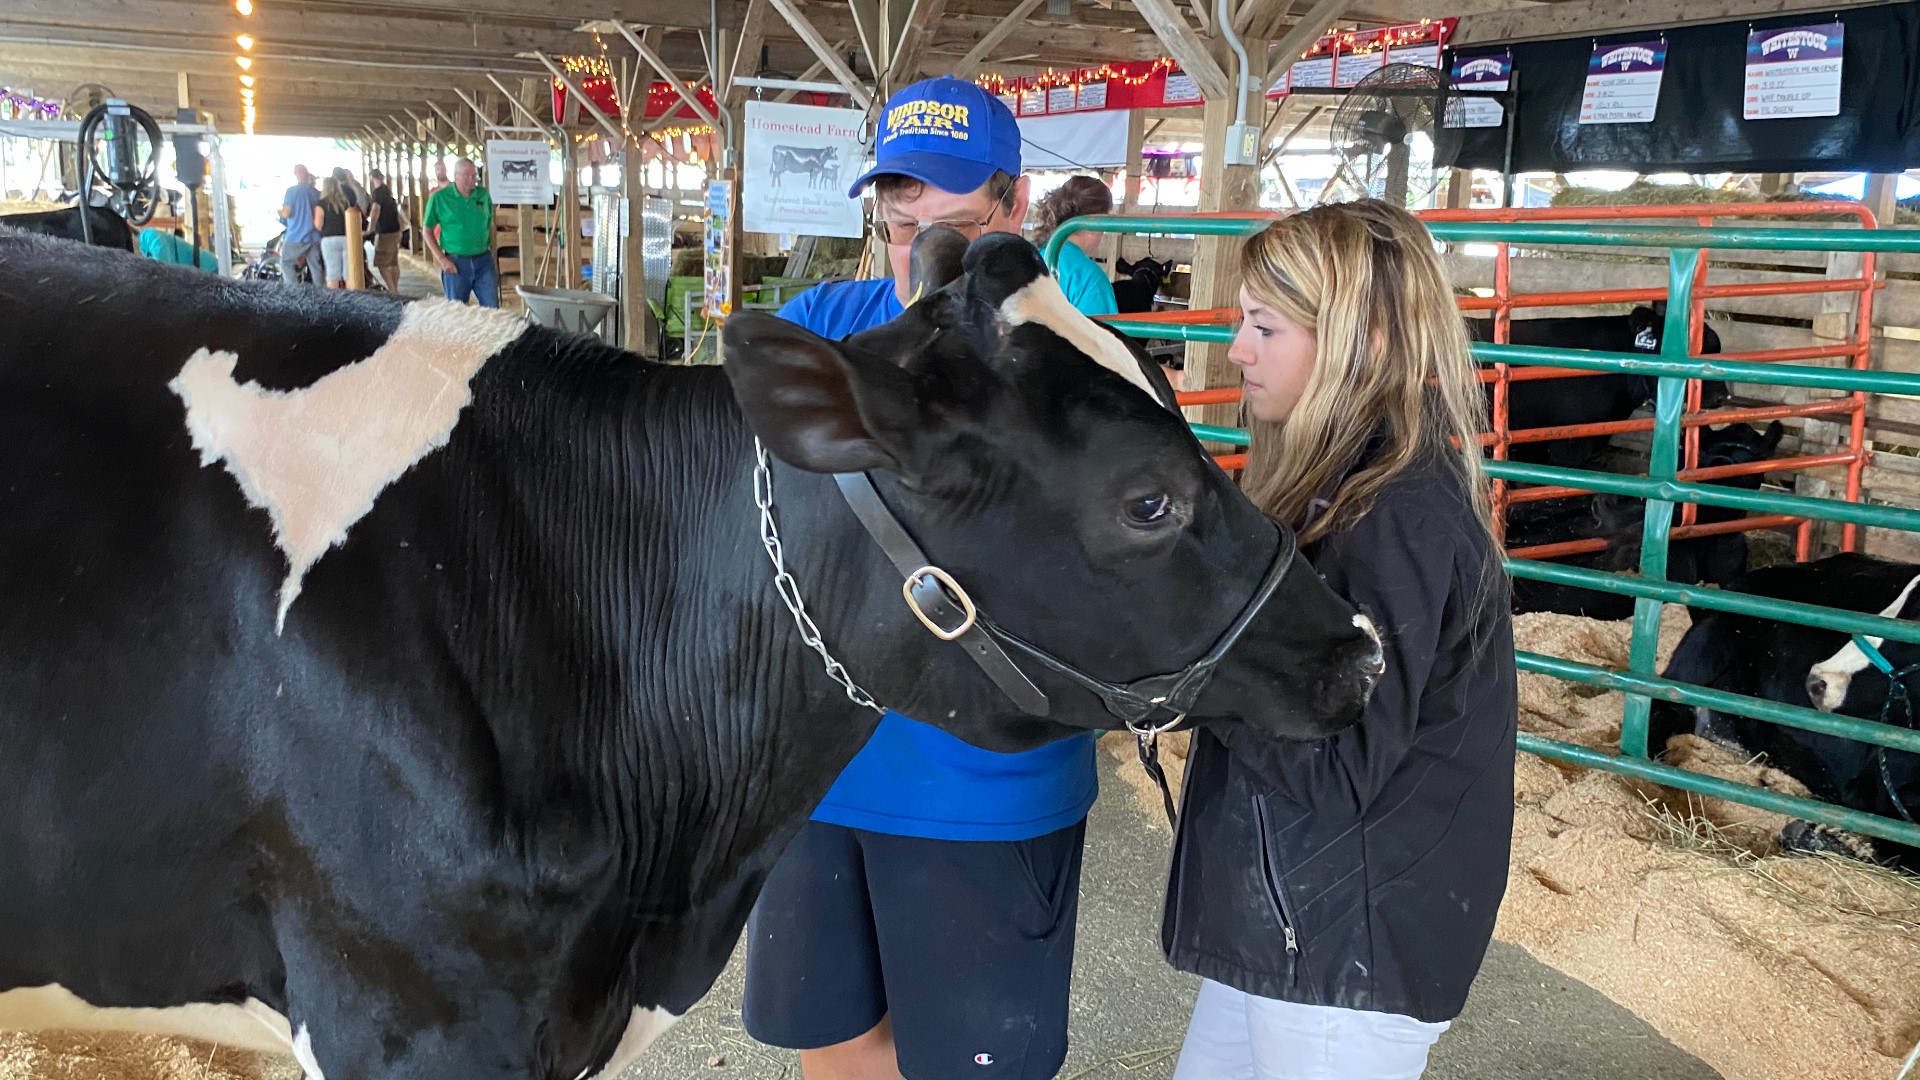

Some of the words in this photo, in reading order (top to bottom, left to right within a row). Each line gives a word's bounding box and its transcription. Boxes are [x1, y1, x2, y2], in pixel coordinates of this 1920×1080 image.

[1761, 30, 1828, 56] WHITESTOCK
[1601, 46, 1654, 68] WHITESTOCK
[1787, 47, 1799, 59] W
[1620, 61, 1630, 71] W
[1476, 72, 1484, 81] W
[886, 100, 969, 131] WINDSOR
[751, 117, 822, 135] Homestead
[828, 124, 858, 138] Farm
[891, 115, 954, 133] FAIR
[900, 126, 928, 136] Tradition
[930, 127, 949, 136] Since
[802, 196, 821, 206] Black
[824, 198, 845, 208] Angus
